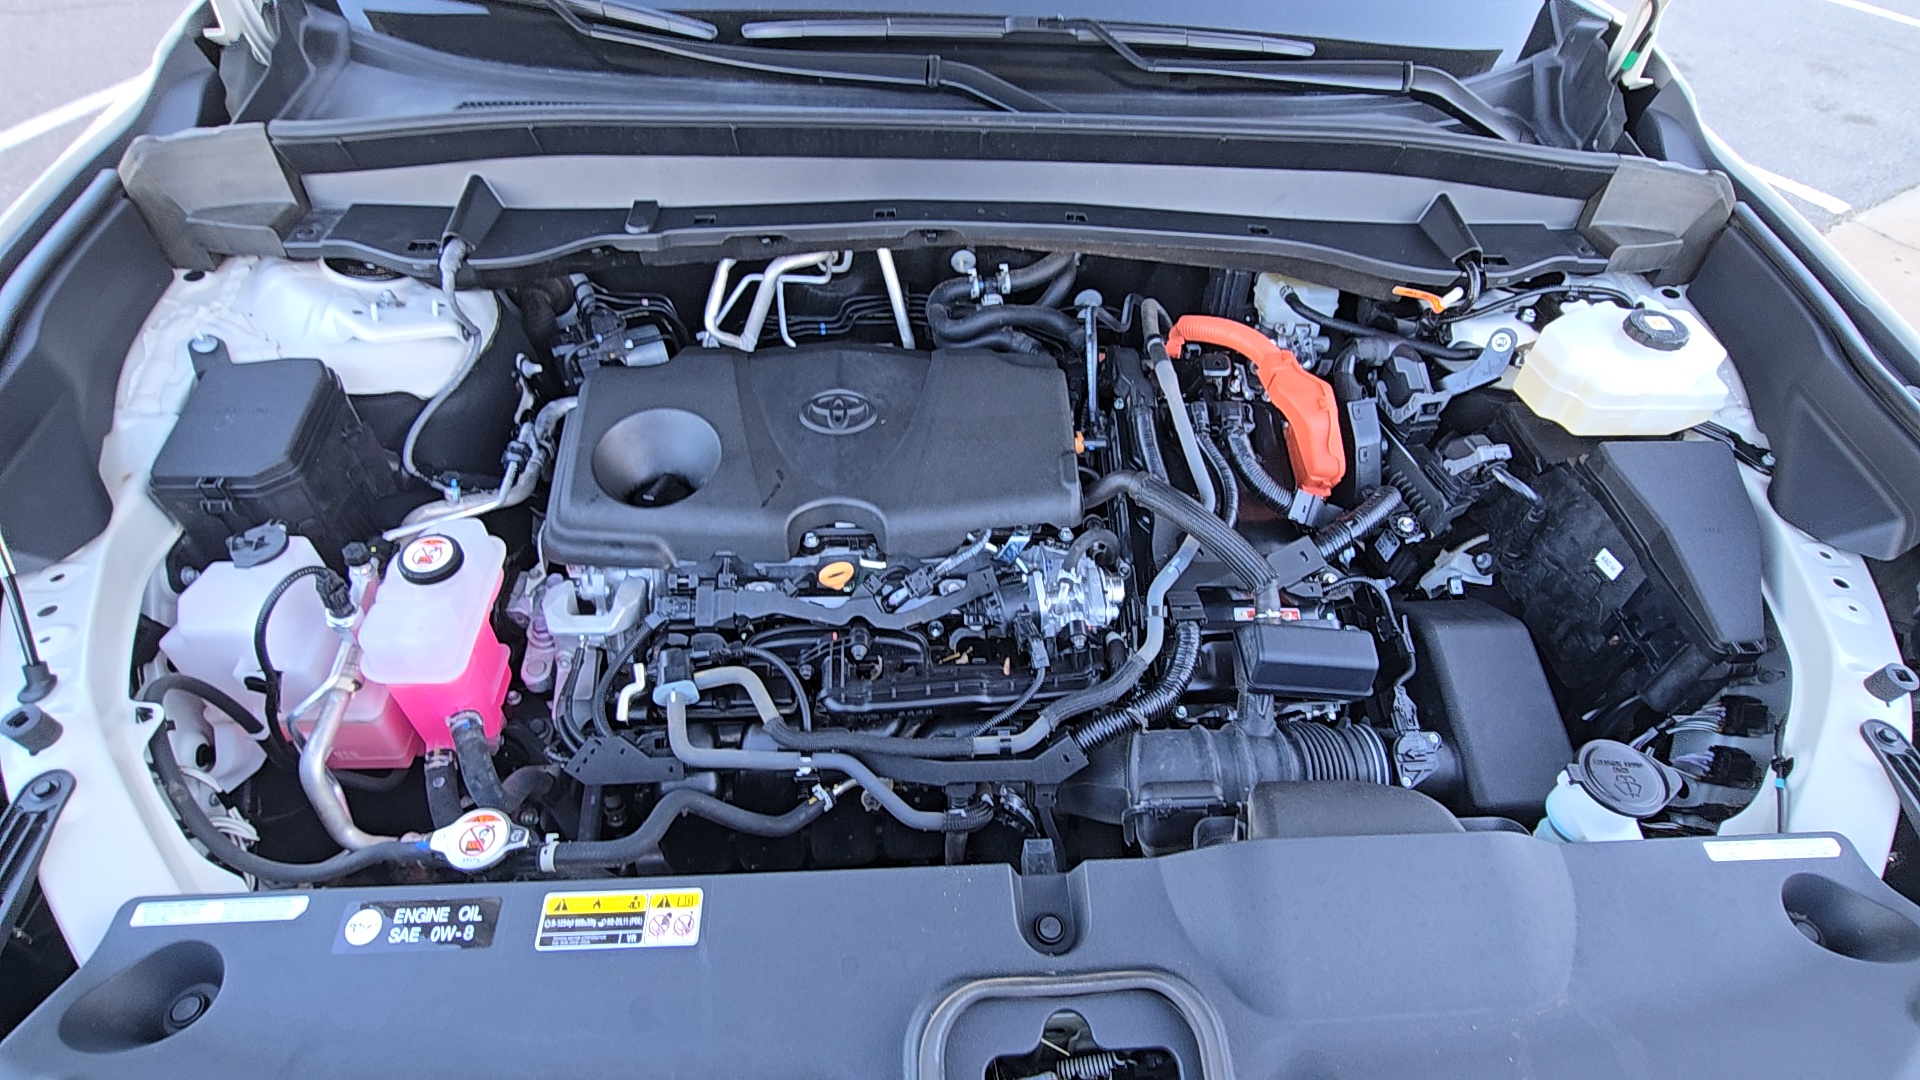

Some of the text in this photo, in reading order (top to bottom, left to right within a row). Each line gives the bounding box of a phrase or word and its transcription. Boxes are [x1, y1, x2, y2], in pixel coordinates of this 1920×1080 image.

[393, 905, 482, 925] ENGINE OIL
[388, 925, 475, 944] SAE 0W-8
